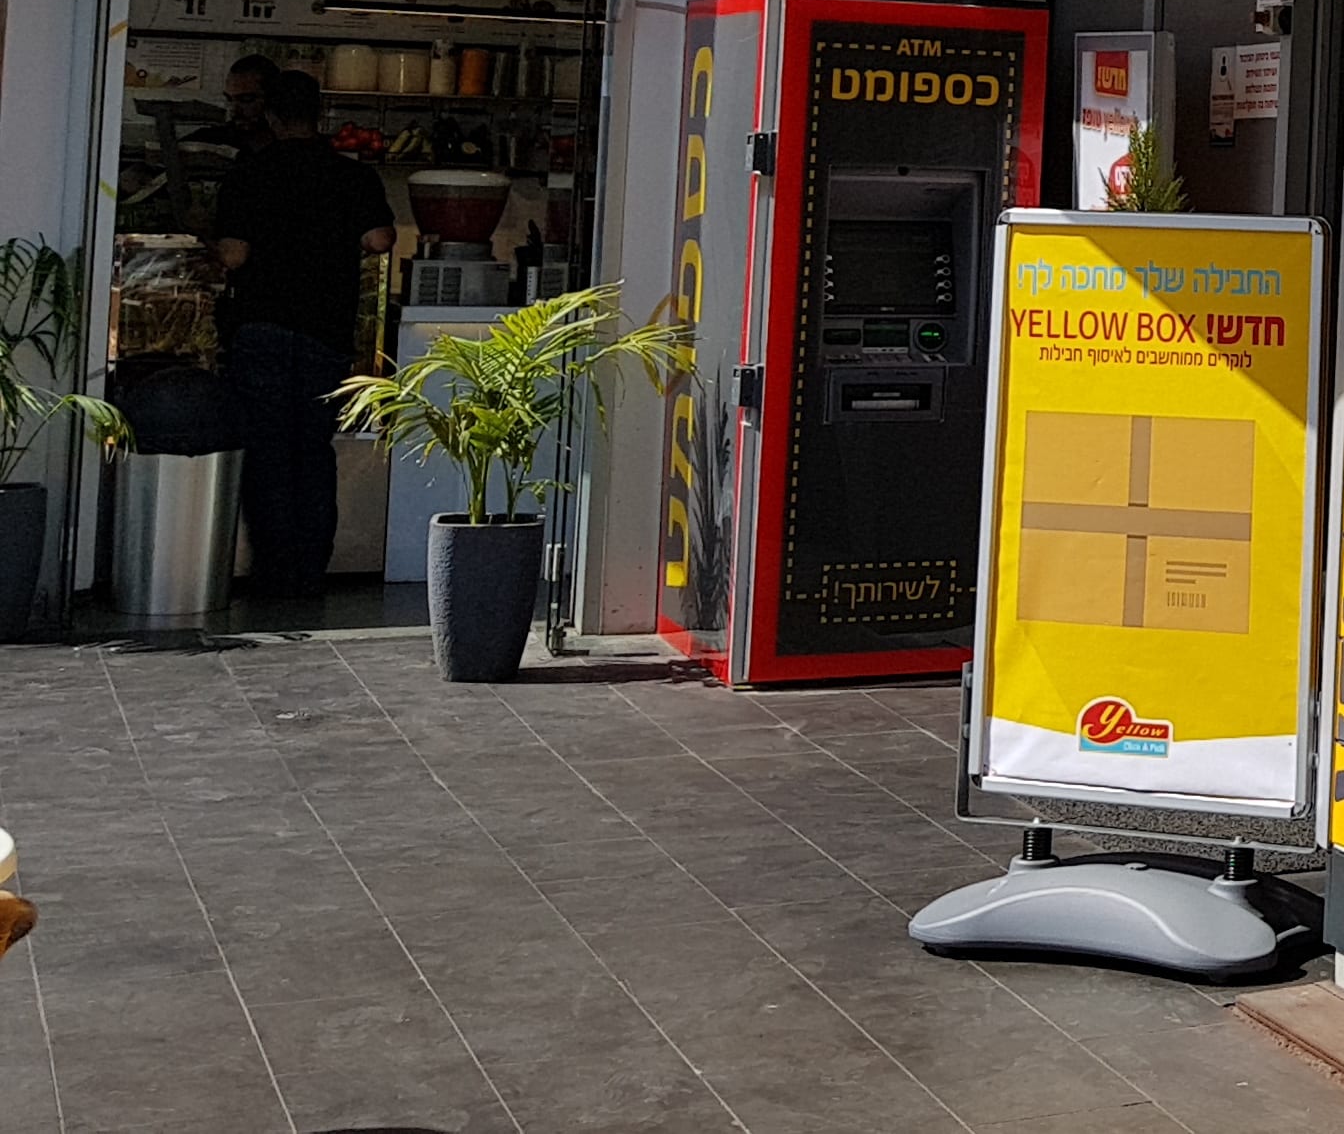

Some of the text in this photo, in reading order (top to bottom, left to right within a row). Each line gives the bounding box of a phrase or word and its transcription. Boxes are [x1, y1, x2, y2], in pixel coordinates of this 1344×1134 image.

[896, 38, 942, 57] ATM
[831, 67, 1000, 107] כספומט
[1017, 258, 1281, 298] החבילה שלך מחכה לך!
[1011, 309, 1285, 347] חדש! YELLOW BOX
[1039, 344, 1252, 371] לוקרים ממוחשבים לאיסוף חבילות
[833, 575, 942, 610] לשירותך!
